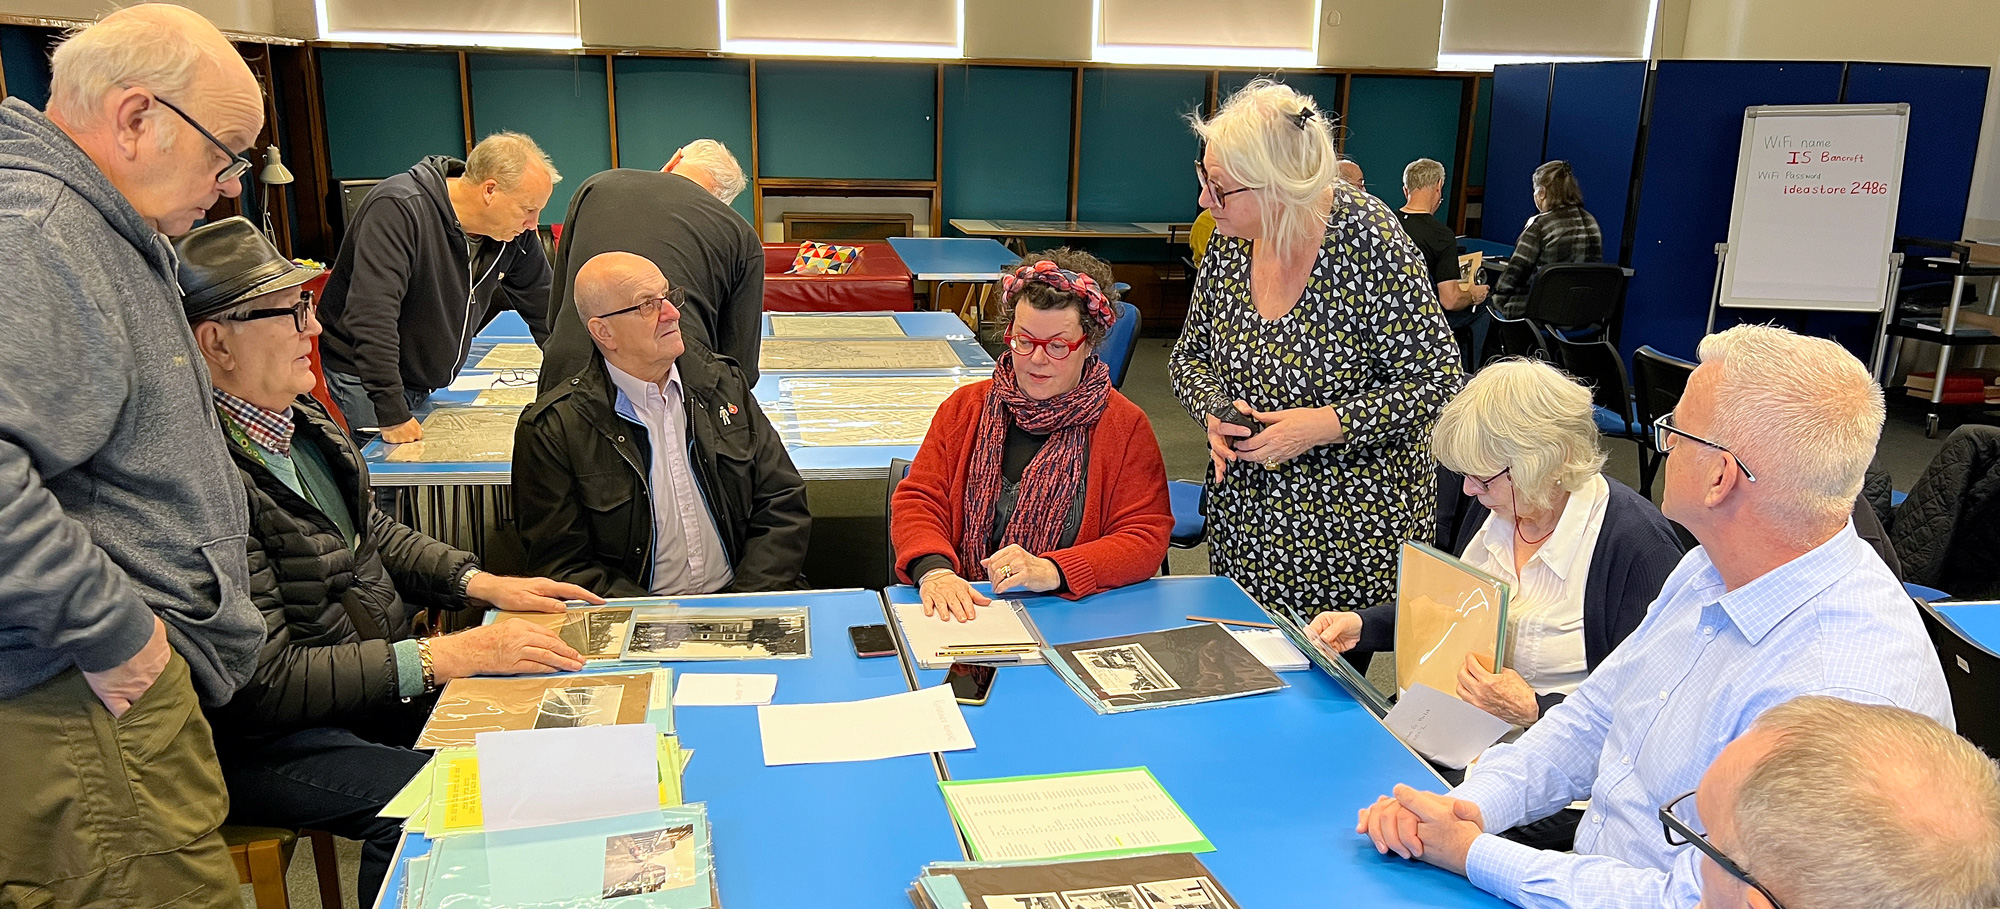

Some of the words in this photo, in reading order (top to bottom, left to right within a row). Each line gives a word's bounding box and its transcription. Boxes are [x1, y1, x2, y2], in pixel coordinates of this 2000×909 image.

[1800, 138, 1832, 148] name
[1786, 151, 1812, 165] IS
[1820, 151, 1864, 163] Bancroft
[1785, 171, 1822, 180] Password
[1850, 181, 1888, 195] 2486
